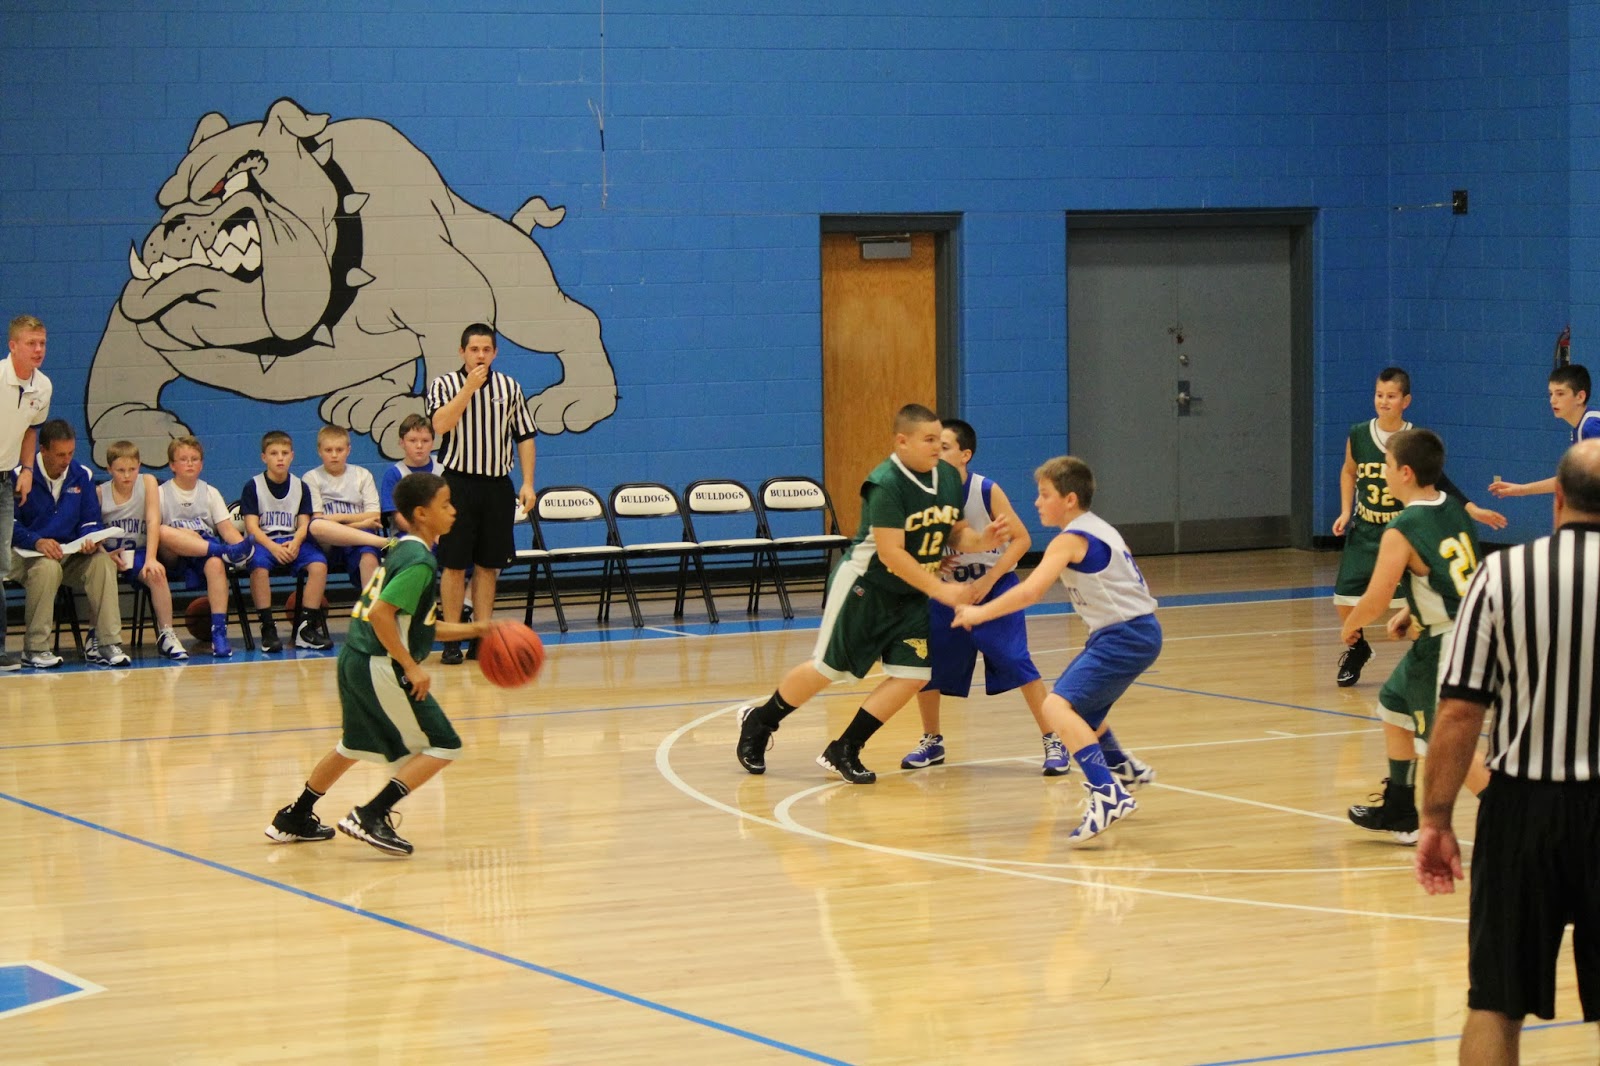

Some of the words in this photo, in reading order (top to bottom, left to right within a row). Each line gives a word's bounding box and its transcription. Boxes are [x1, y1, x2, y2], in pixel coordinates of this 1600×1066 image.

[620, 494, 670, 504] BULLDOGS
[695, 491, 744, 501] BULLDOGS
[770, 488, 819, 498] BULLDOGS
[1367, 484, 1395, 506] 32
[544, 498, 595, 507] BULLDOGS
[259, 512, 292, 527] LINTON
[918, 531, 944, 556] 12
[1439, 531, 1477, 597] 21
